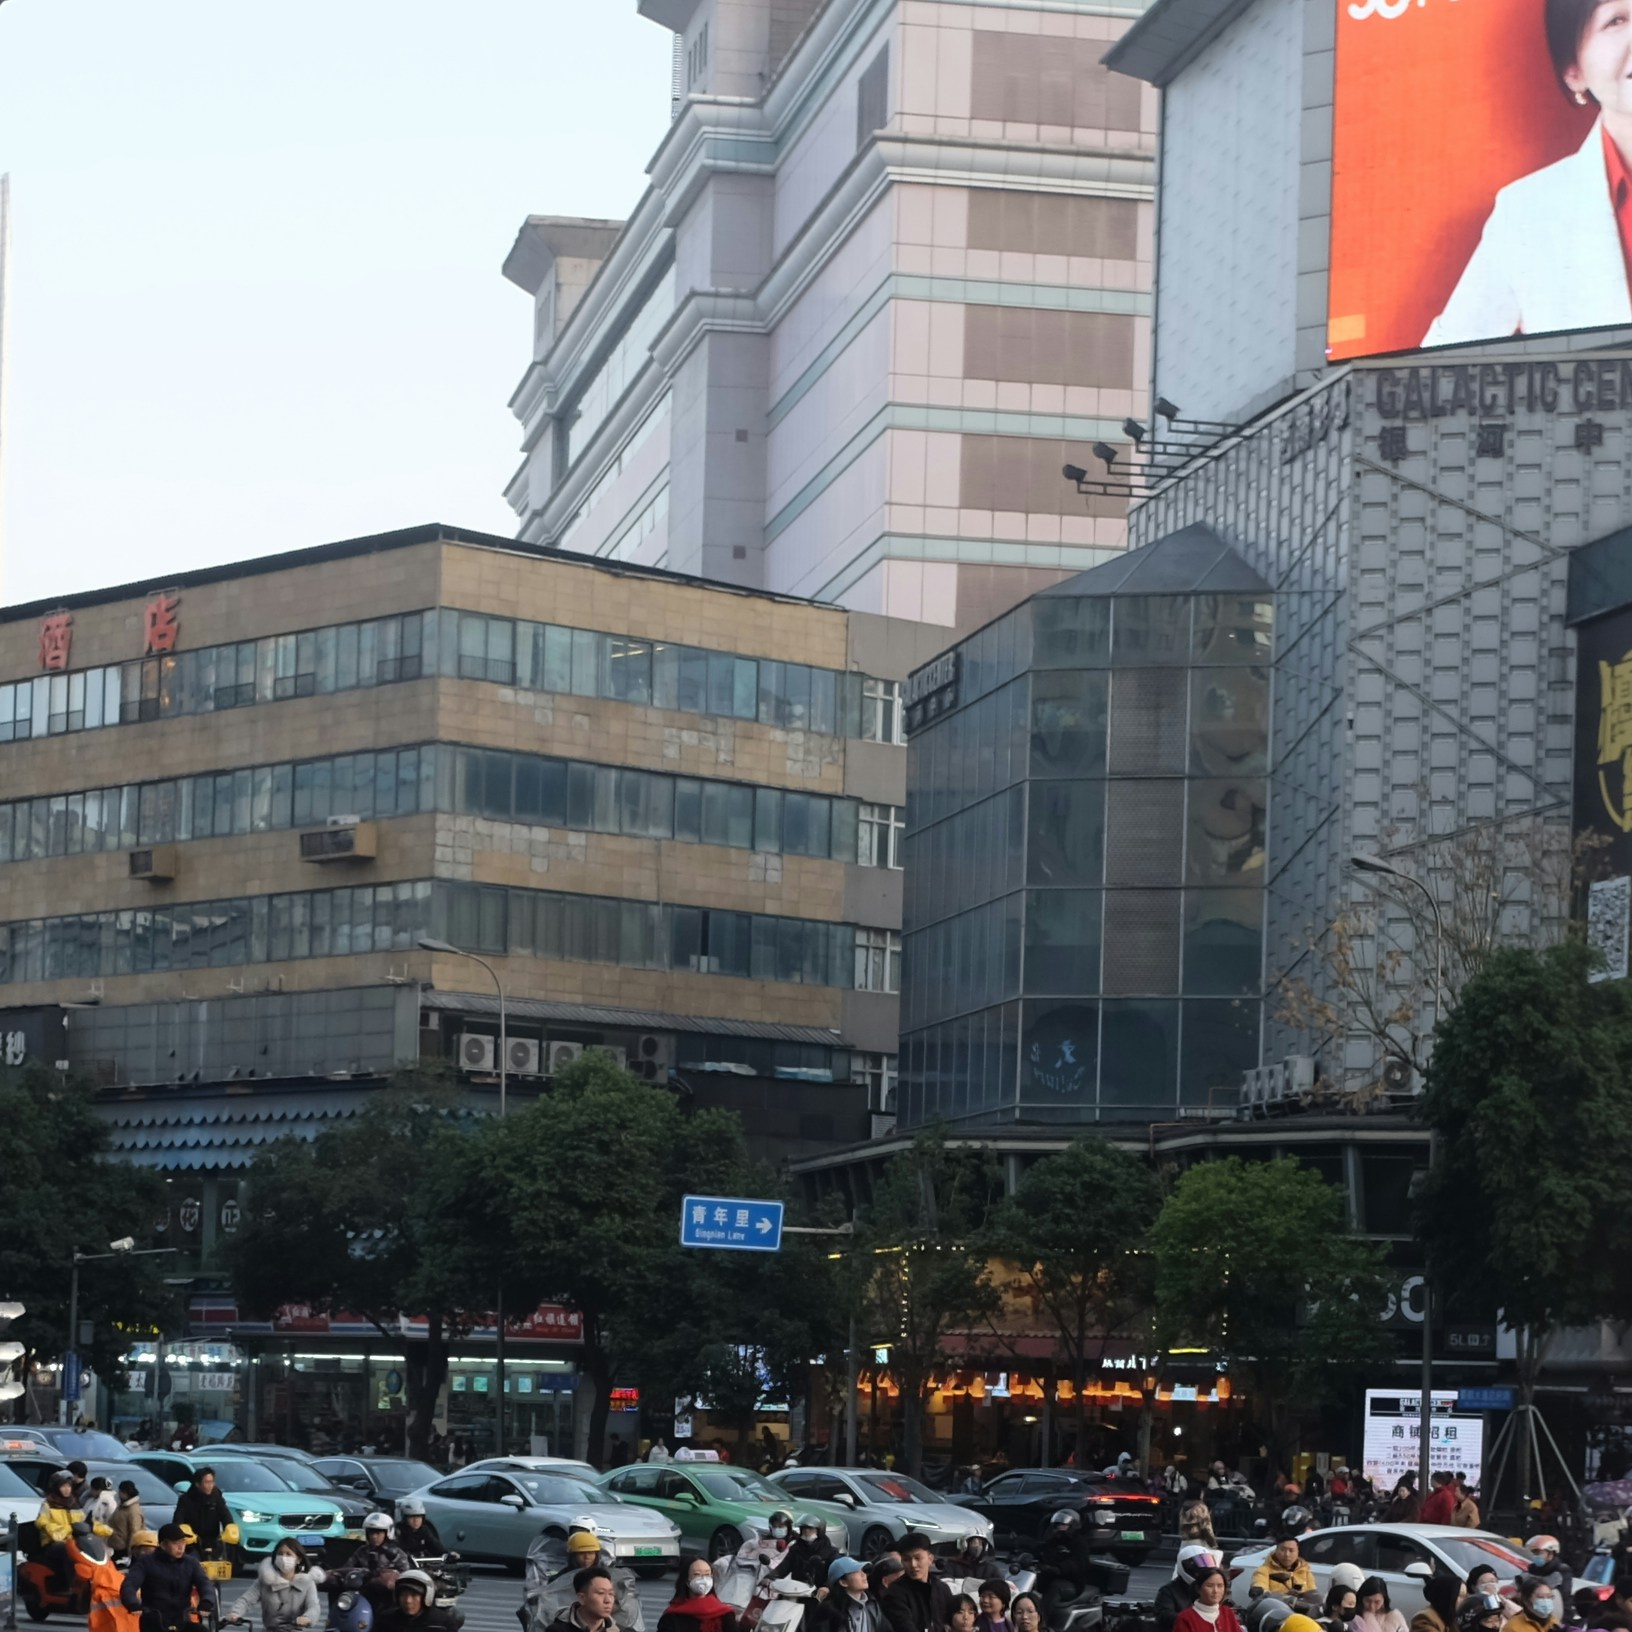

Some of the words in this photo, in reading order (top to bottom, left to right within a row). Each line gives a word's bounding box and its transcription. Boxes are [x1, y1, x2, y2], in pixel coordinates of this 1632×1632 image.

[1376, 360, 1559, 418] GALACTIC
[692, 1205, 750, 1228] 青年里
